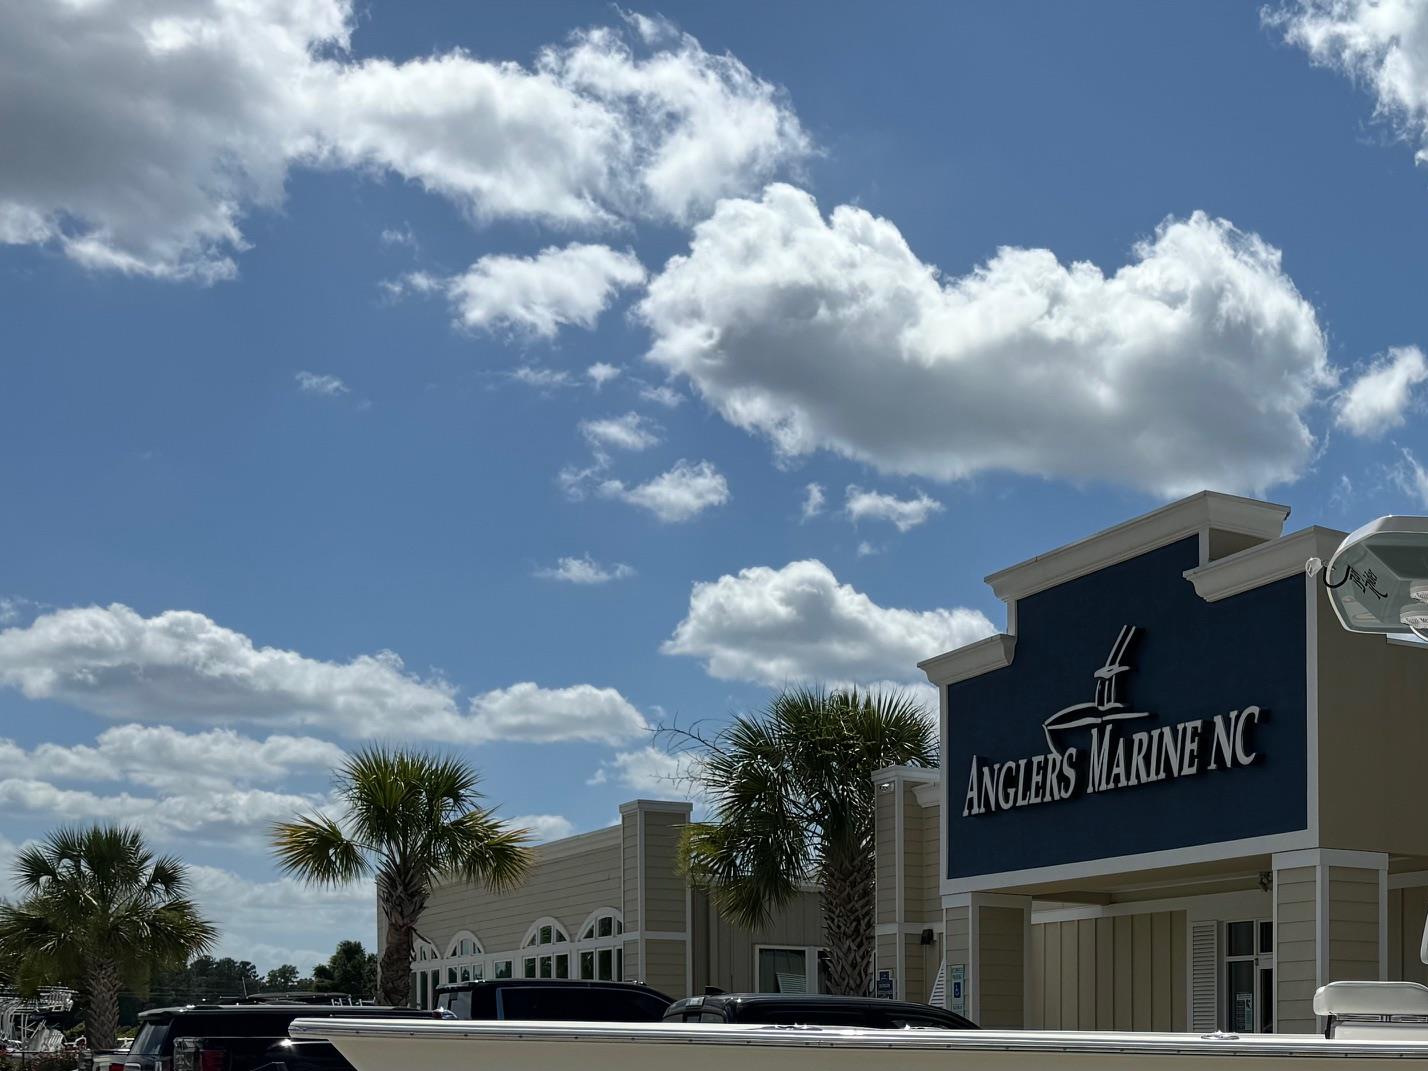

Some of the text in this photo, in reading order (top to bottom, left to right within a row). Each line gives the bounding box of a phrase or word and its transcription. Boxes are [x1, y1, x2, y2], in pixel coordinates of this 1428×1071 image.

[962, 705, 1260, 817] ANGLERS MARINE NC
